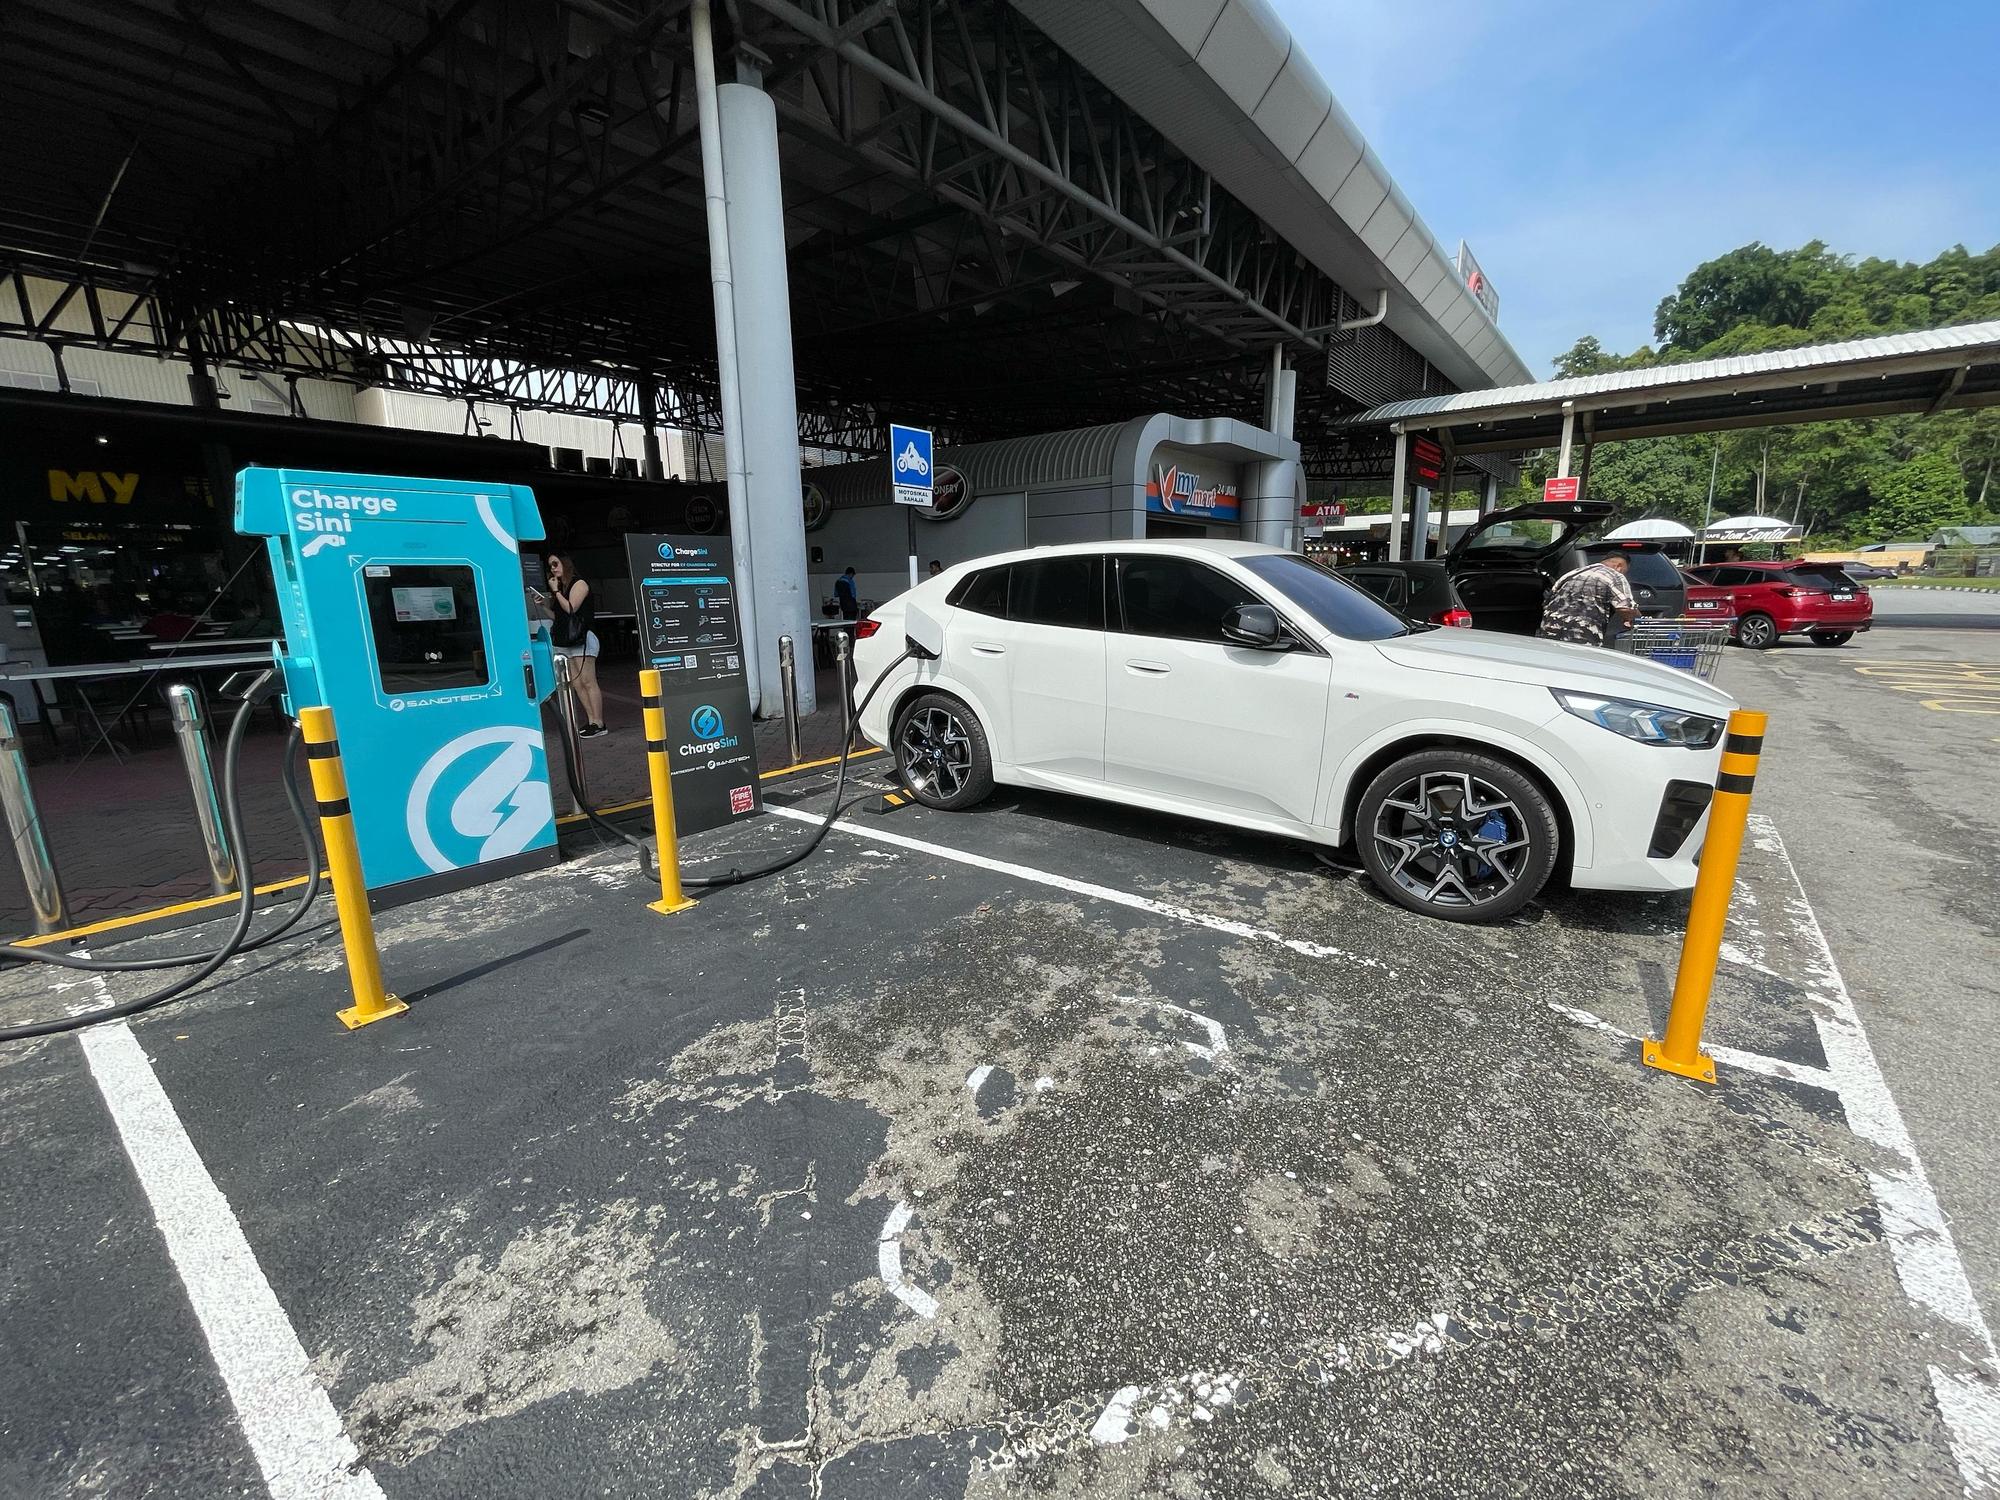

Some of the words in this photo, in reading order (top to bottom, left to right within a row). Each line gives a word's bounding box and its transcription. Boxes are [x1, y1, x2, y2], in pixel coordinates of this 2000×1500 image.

[48, 469, 140, 504] MY
[898, 489, 929, 497] MOTOSIKAL
[292, 489, 398, 515] Charge
[1315, 505, 1341, 516] ATM
[295, 511, 352, 532] Sini
[675, 547, 708, 556] ChargeSini
[679, 735, 738, 756] ChargeSini
[734, 791, 750, 801] FIRE
